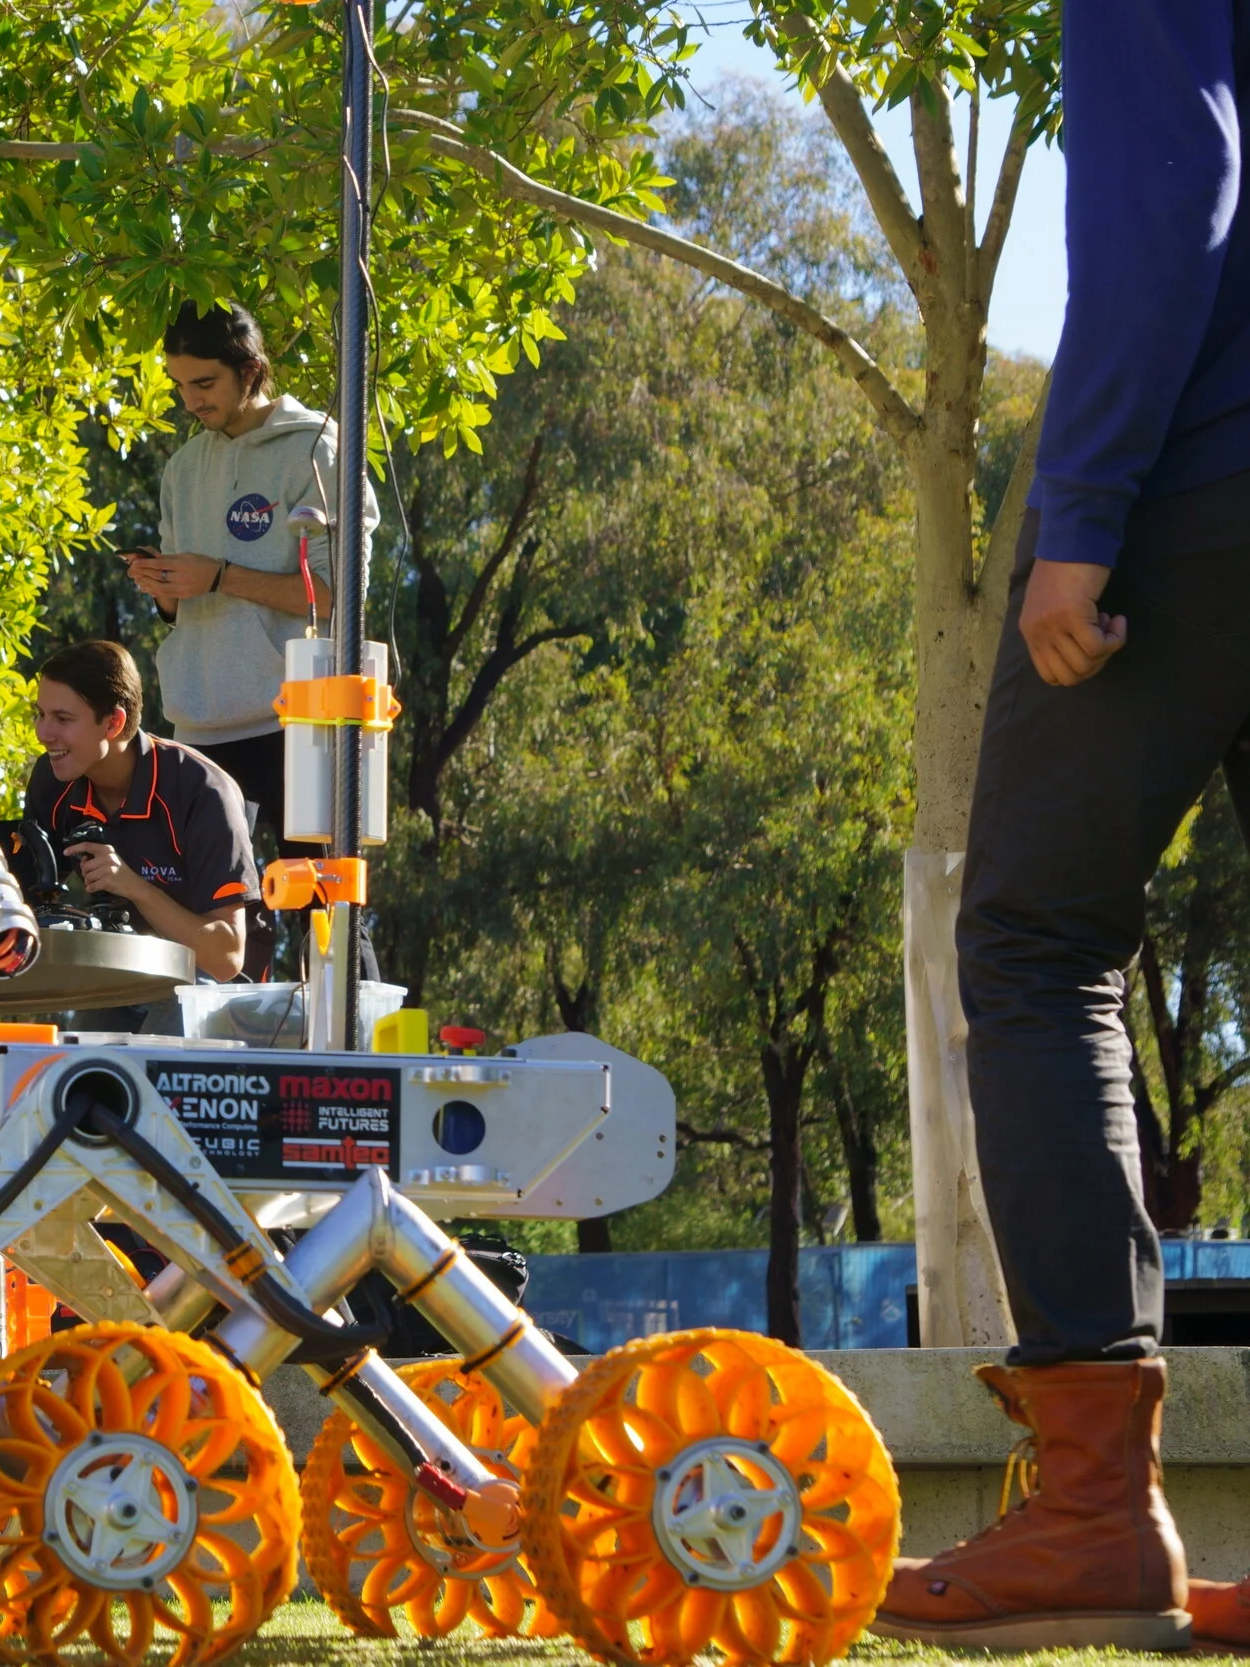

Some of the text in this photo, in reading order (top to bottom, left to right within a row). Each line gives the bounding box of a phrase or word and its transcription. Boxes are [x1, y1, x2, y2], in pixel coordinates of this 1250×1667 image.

[230, 511, 270, 523] NASA
[141, 866, 176, 876] NOVA
[156, 1072, 270, 1095] ALTRONICS
[279, 1075, 392, 1101] maxon
[318, 1106, 389, 1118] INTELLIGENT
[181, 1121, 258, 1132] erformance Computing
[318, 1118, 389, 1132] FUTURES
[282, 1136, 389, 1169] samtec
